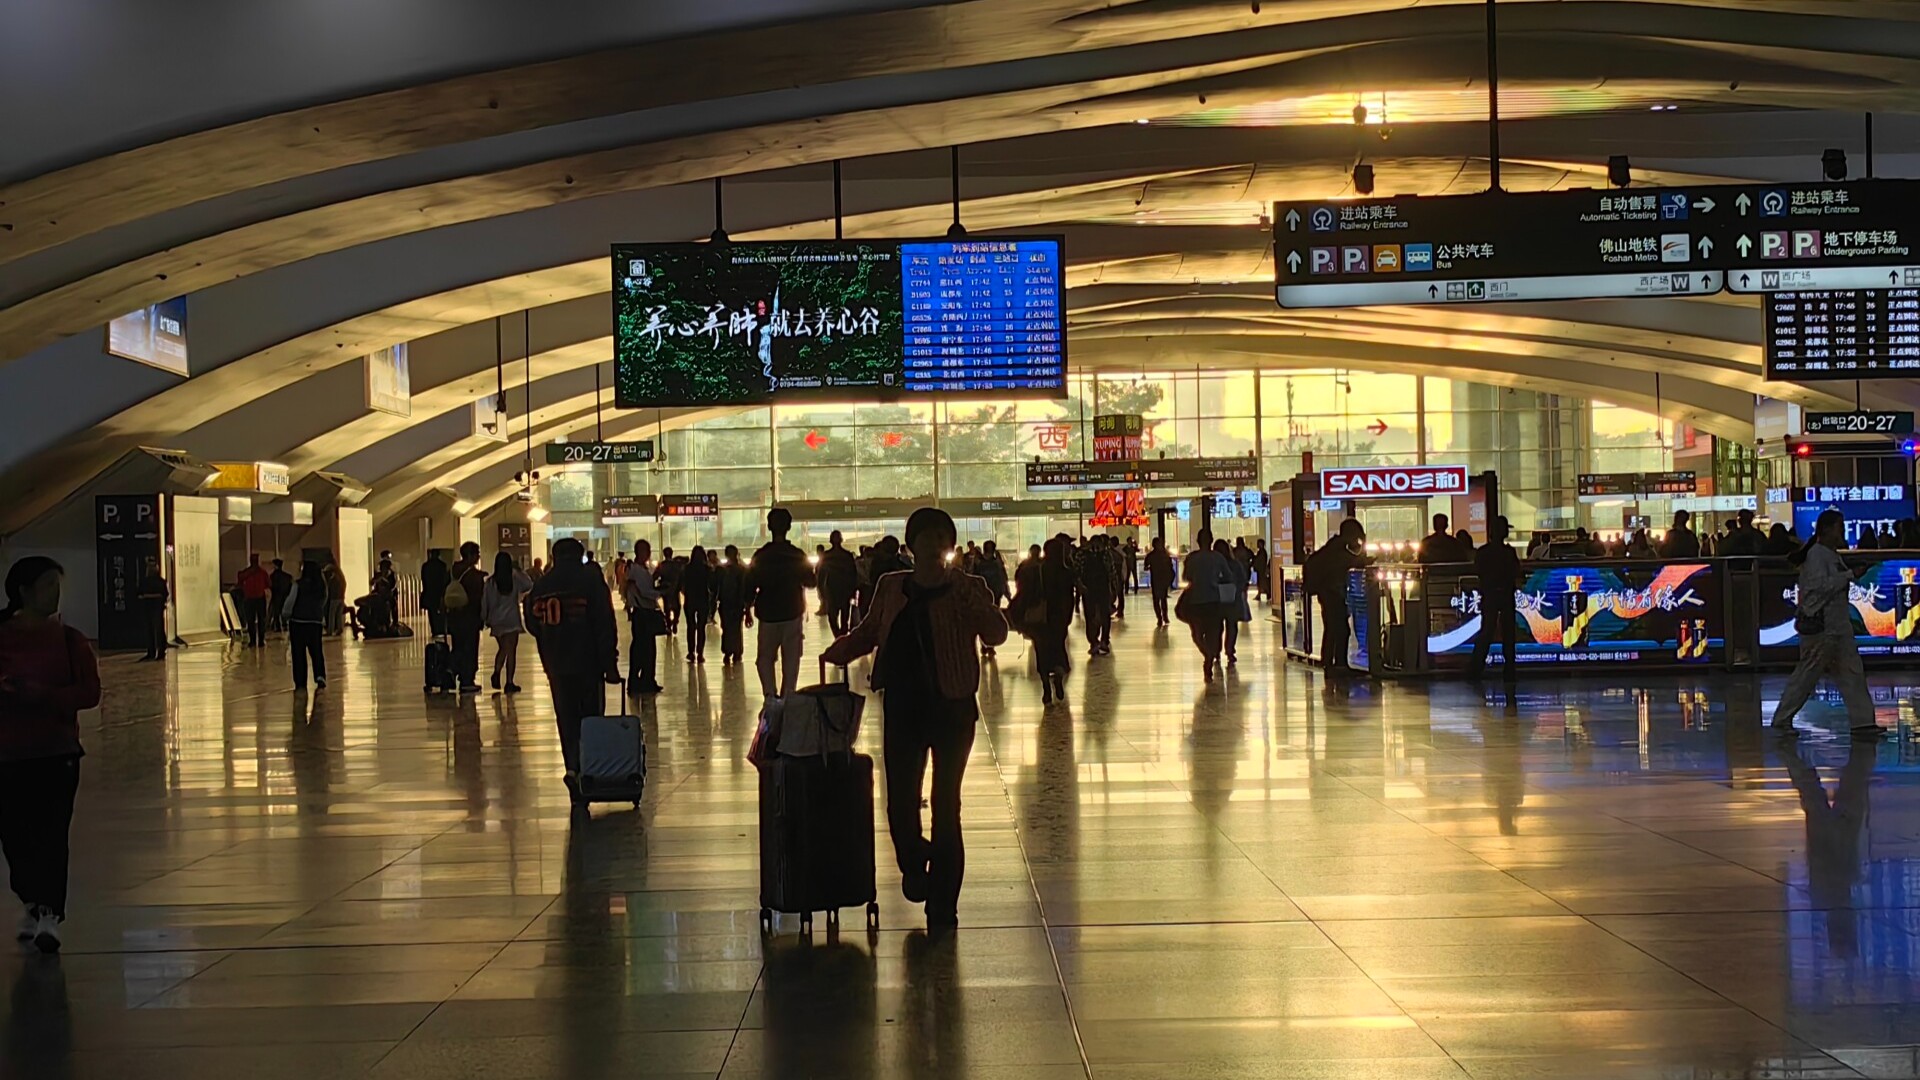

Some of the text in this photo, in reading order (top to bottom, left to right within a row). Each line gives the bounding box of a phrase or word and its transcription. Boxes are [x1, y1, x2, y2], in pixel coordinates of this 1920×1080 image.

[1600, 196, 1656, 211] 自动售票
[1791, 189, 1849, 205] 进站乘车
[1341, 205, 1397, 220] 进站乘车
[1580, 212, 1657, 221] Automatic Ticketing
[1340, 221, 1408, 230] Railway Entrance
[1599, 237, 1657, 253] 佛山地铁
[1763, 233, 1785, 256] P2
[1795, 232, 1817, 255] P6
[1824, 230, 1898, 246] 地下停车场
[1437, 243, 1494, 258] 公共汽车
[1603, 254, 1632, 262] Foshan
[1824, 246, 1908, 257] Underground Parking
[1312, 249, 1334, 272] P3
[1344, 248, 1366, 271] P4
[1640, 275, 1669, 285] 西广场
[1673, 277, 1688, 289] W
[1763, 274, 1778, 286] W
[1782, 270, 1810, 281] 西广场
[770, 307, 880, 337] 就去养心谷
[1847, 415, 1896, 430] 20-27
[1033, 424, 1072, 450] 西
[1095, 437, 1121, 450] XUPING
[564, 445, 612, 461] 20-27
[1820, 485, 1903, 501] 富轩全屋门窗
